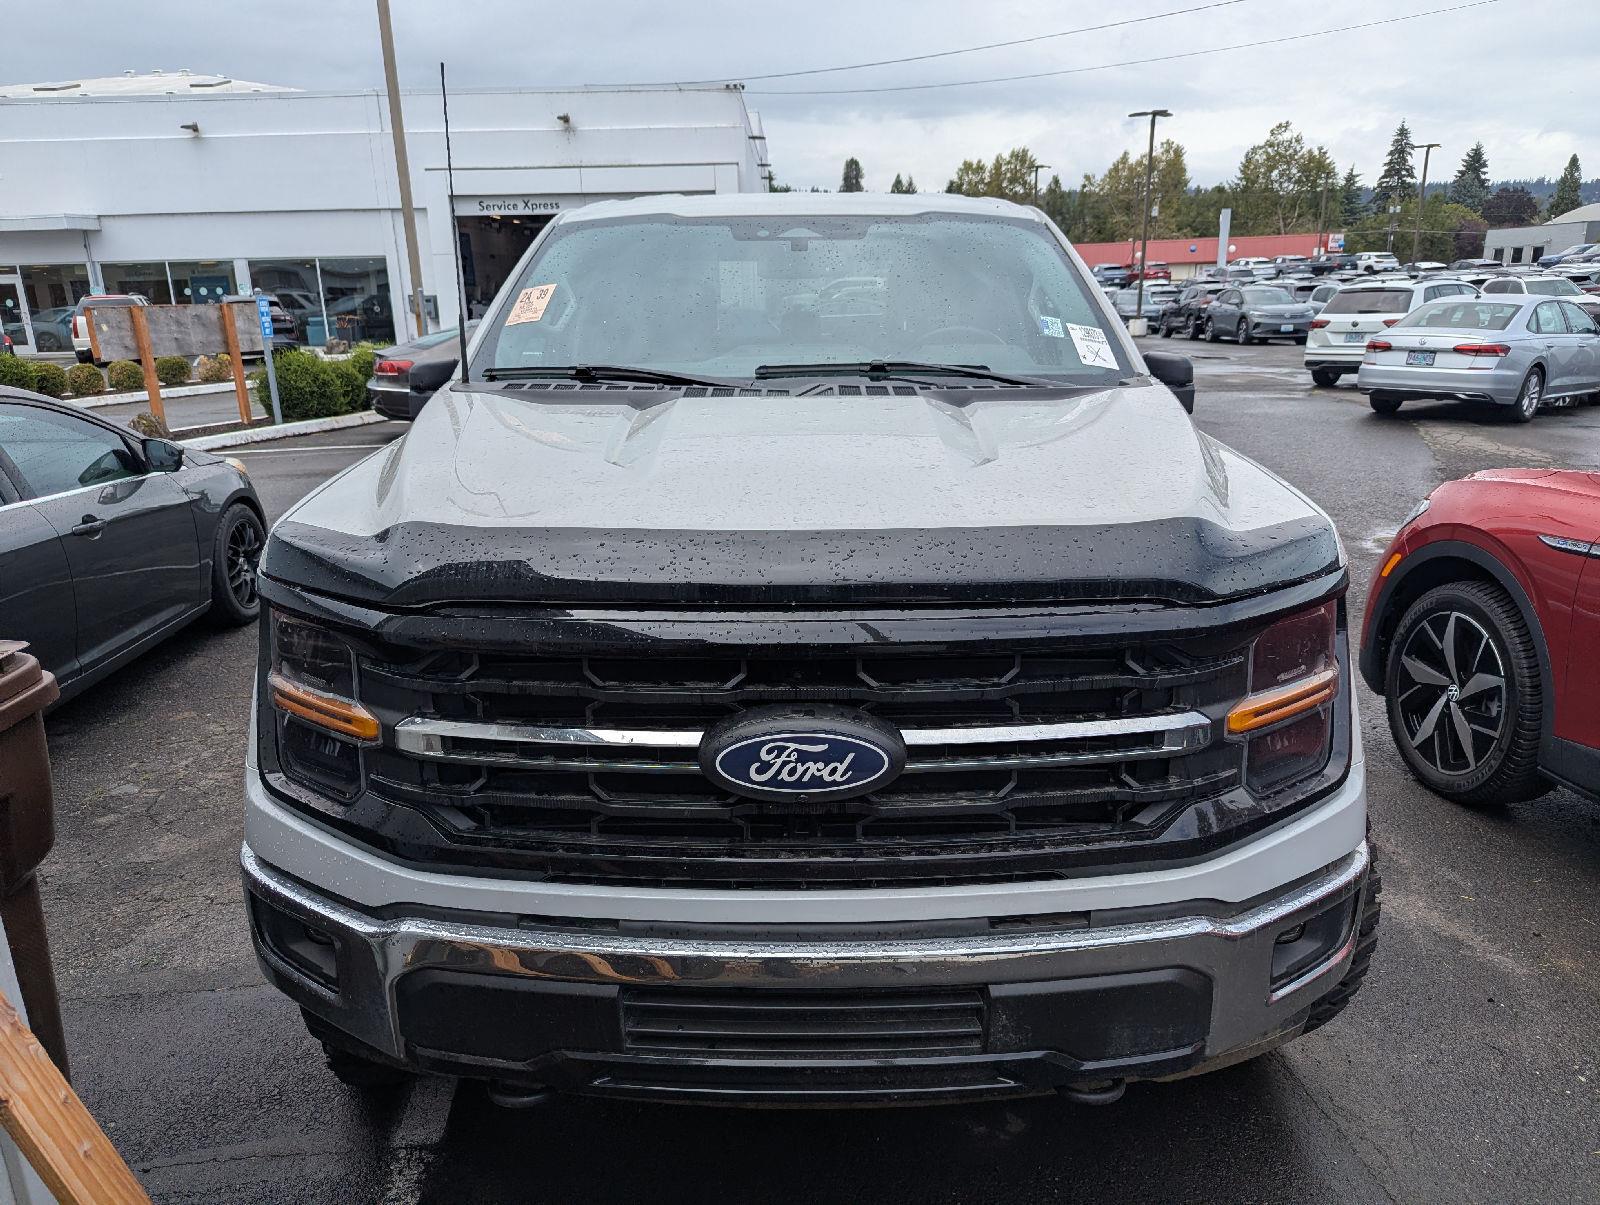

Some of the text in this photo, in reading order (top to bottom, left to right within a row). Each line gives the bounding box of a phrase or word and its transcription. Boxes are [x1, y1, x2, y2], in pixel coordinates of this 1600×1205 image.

[478, 199, 561, 212] Service Xpress
[750, 742, 855, 782] Ford
